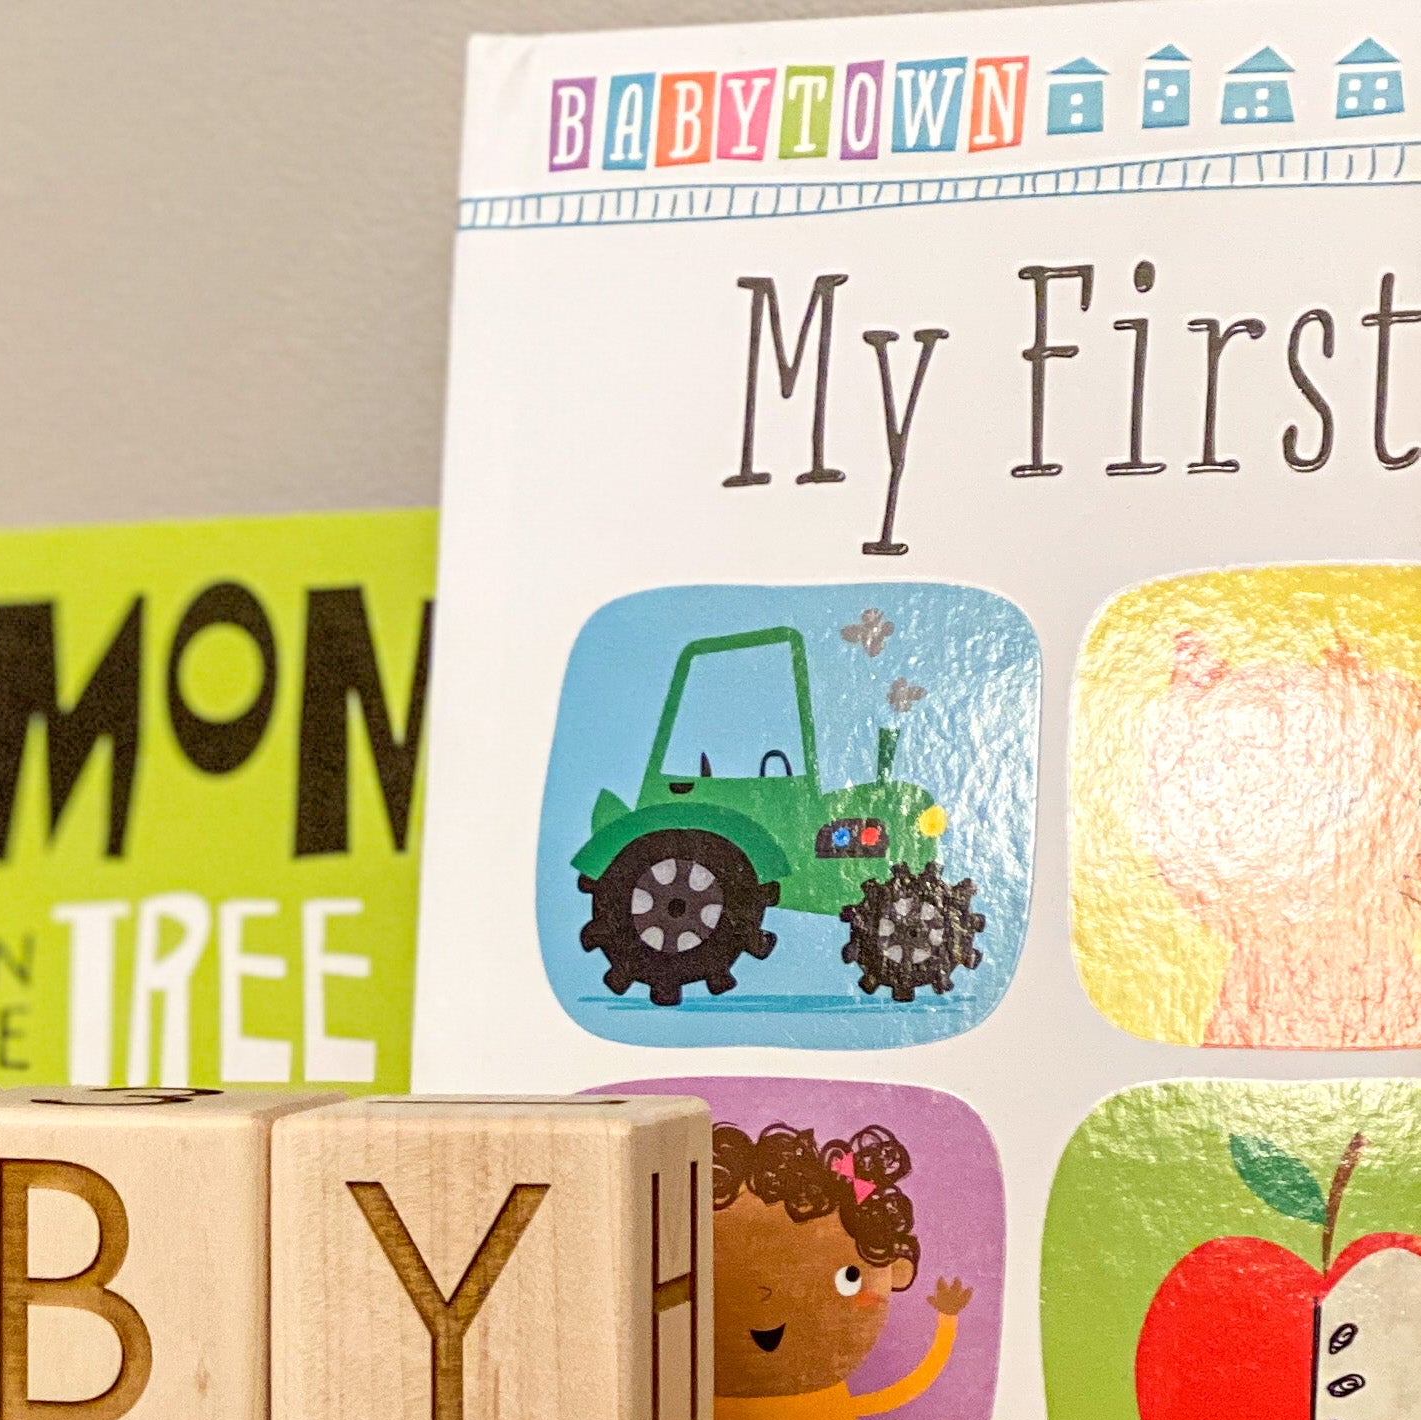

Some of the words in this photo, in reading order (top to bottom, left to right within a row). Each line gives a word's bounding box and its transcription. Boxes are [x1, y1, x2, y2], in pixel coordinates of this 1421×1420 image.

[554, 60, 1026, 167] BABYTOWN
[722, 273, 949, 555] My
[1009, 261, 1421, 474] First
[50, 891, 377, 1087] TREE
